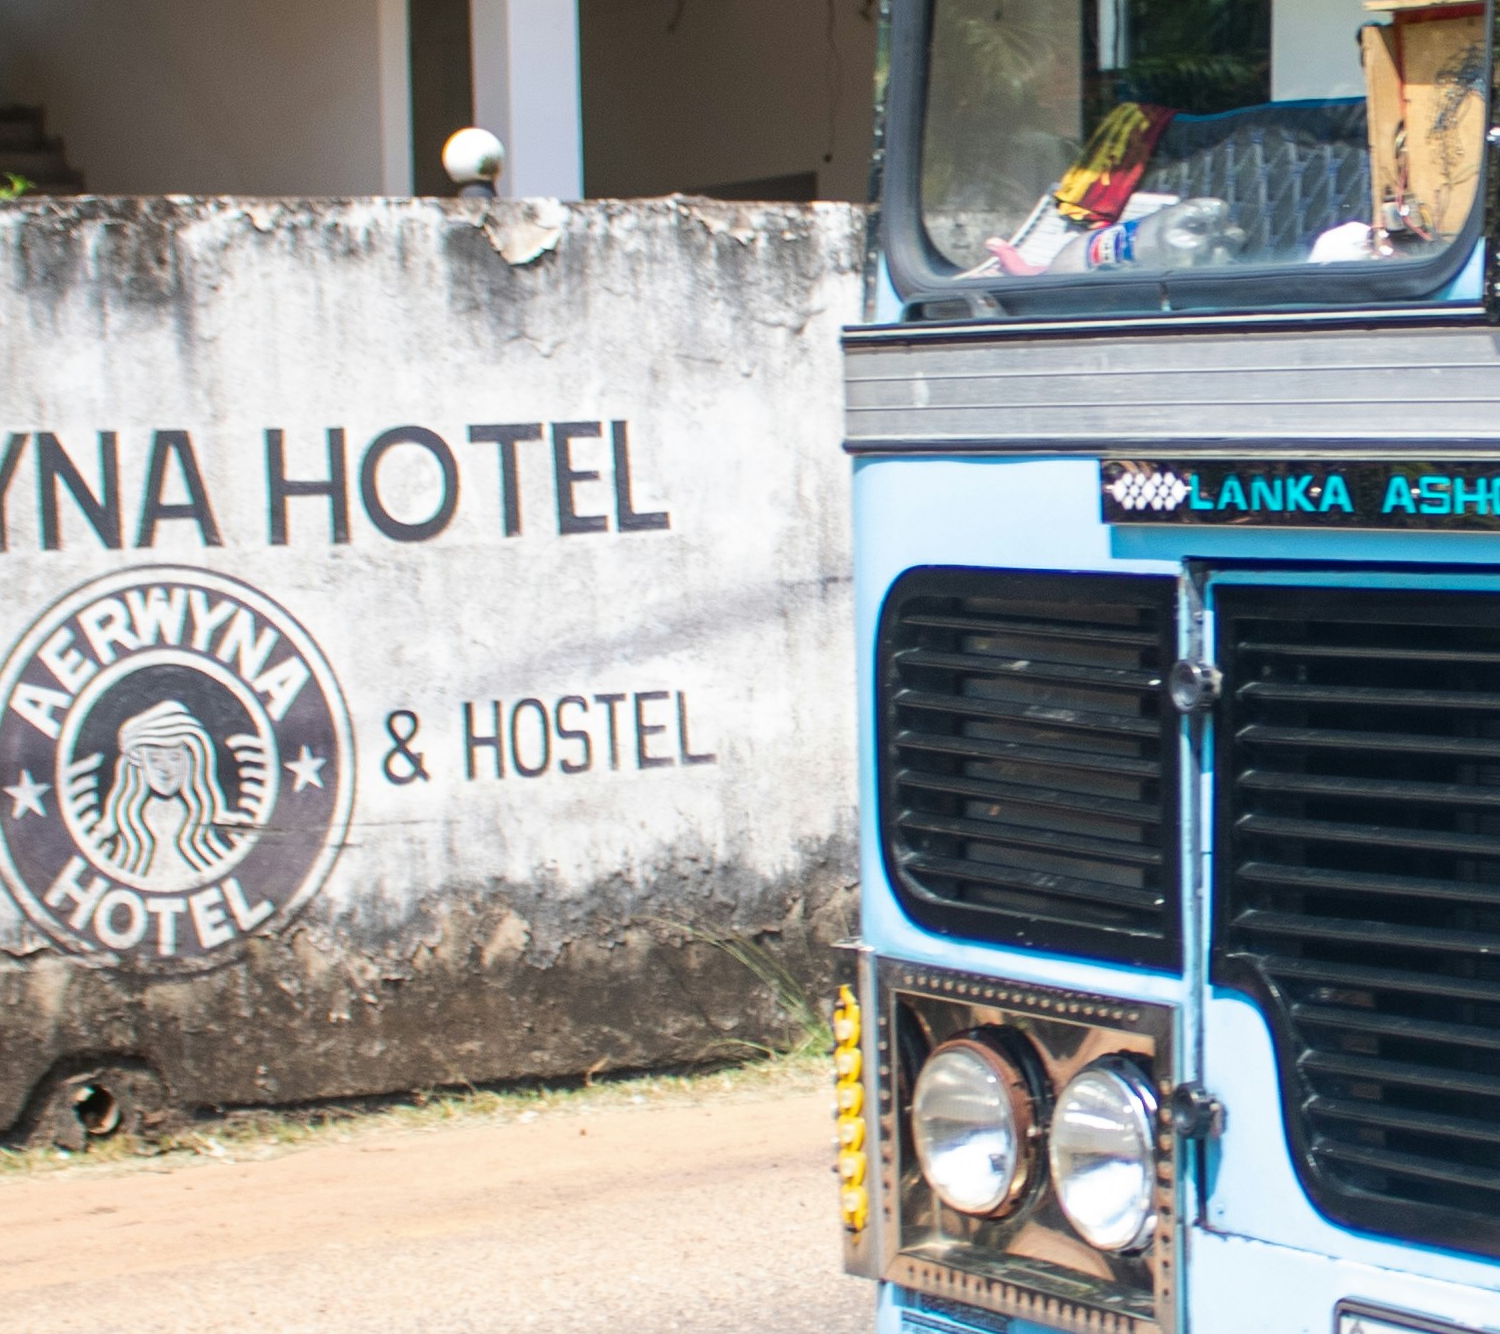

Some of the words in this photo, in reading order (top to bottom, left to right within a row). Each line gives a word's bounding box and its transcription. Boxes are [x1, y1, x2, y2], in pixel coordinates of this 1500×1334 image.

[264, 420, 672, 548] HOTEL
[1189, 473, 1355, 513] LANKA
[8, 586, 312, 740] AERWYNA
[380, 709, 430, 786] &
[464, 689, 717, 782] HOSTEL
[43, 855, 276, 956] HOTEL
